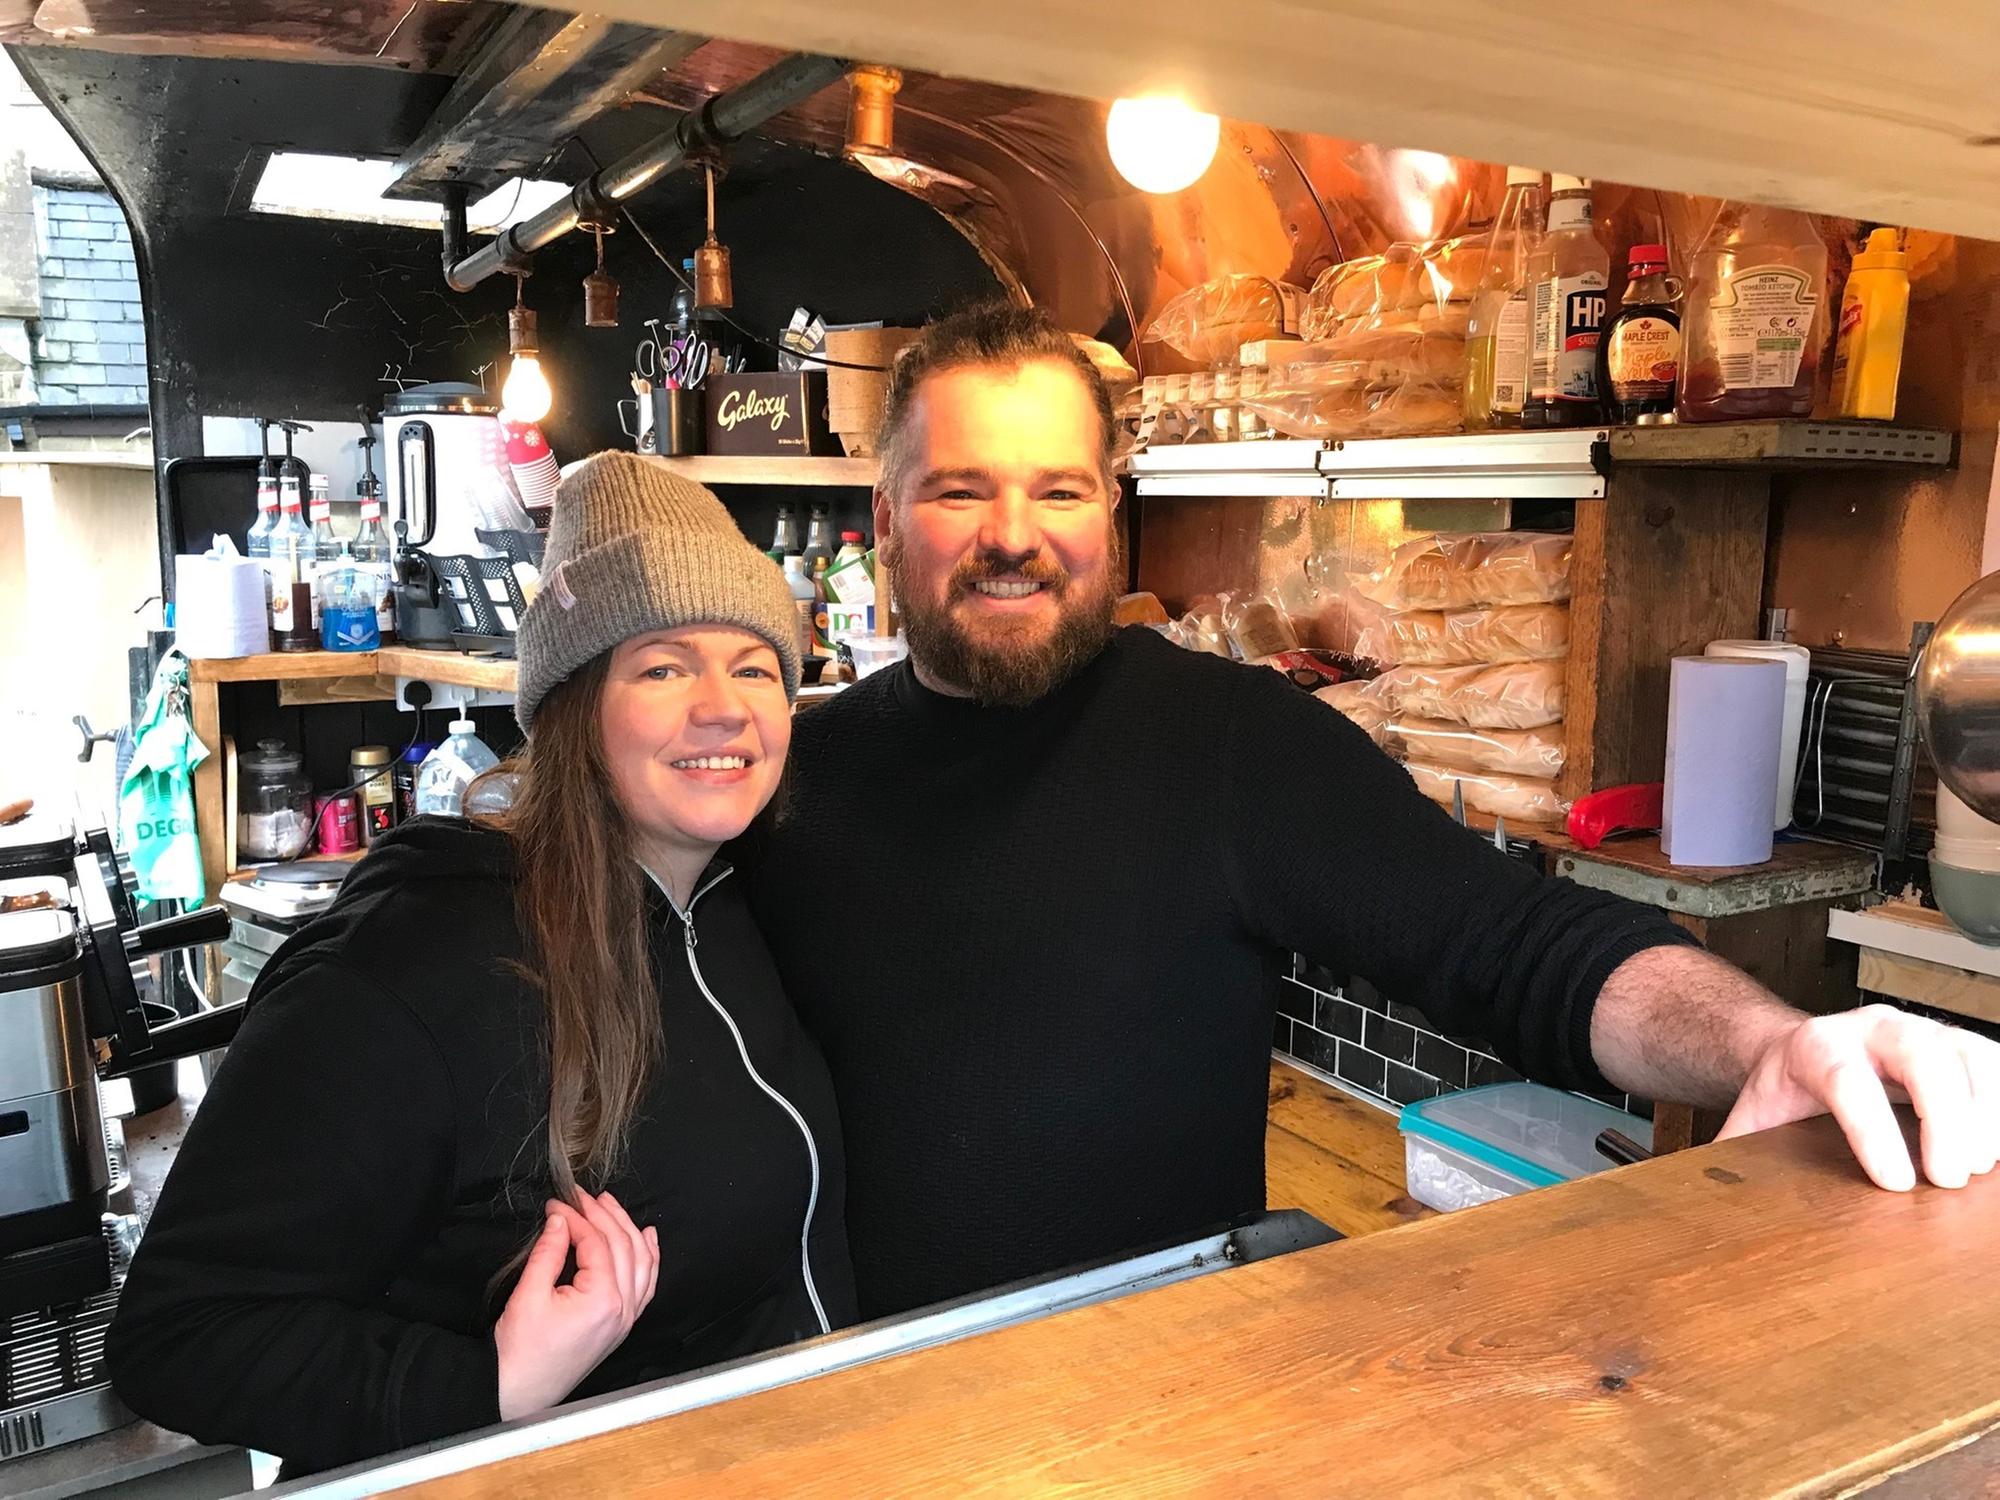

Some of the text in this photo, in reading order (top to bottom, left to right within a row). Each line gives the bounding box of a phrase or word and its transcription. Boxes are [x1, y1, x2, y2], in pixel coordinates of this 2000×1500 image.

[1572, 296, 1606, 328] HP
[1622, 331, 1670, 341] MAPLE CREST
[717, 389, 791, 432] Galaxy
